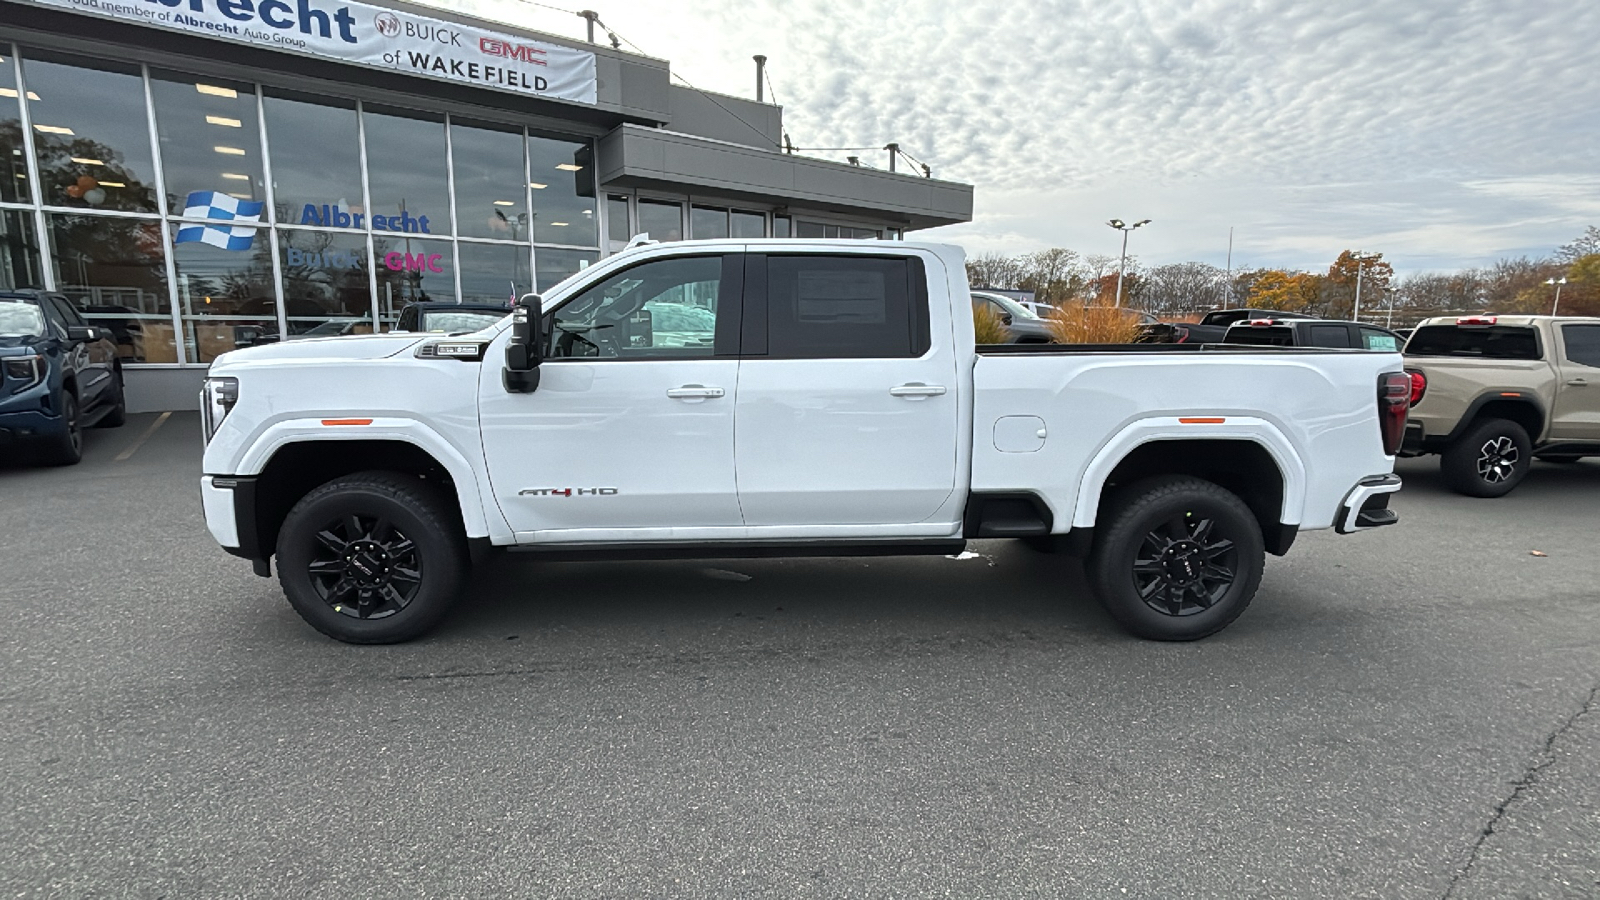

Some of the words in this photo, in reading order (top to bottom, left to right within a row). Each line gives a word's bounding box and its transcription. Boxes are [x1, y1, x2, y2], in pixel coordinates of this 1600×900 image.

[102, 2, 155, 18] member
[157, 12, 171, 21] of
[173, 14, 239, 35] Albrecht
[243, 27, 270, 41] Auto
[273, 33, 306, 48] Group
[406, 21, 462, 47] BUICK
[480, 37, 548, 67] GMC
[383, 50, 401, 65] of
[408, 51, 548, 91] WAKEFIELD
[301, 203, 431, 234] Albrecht
[287, 248, 361, 270] Buick
[384, 251, 443, 273] GMC
[518, 487, 572, 498] AT4
[577, 487, 618, 496] HD
